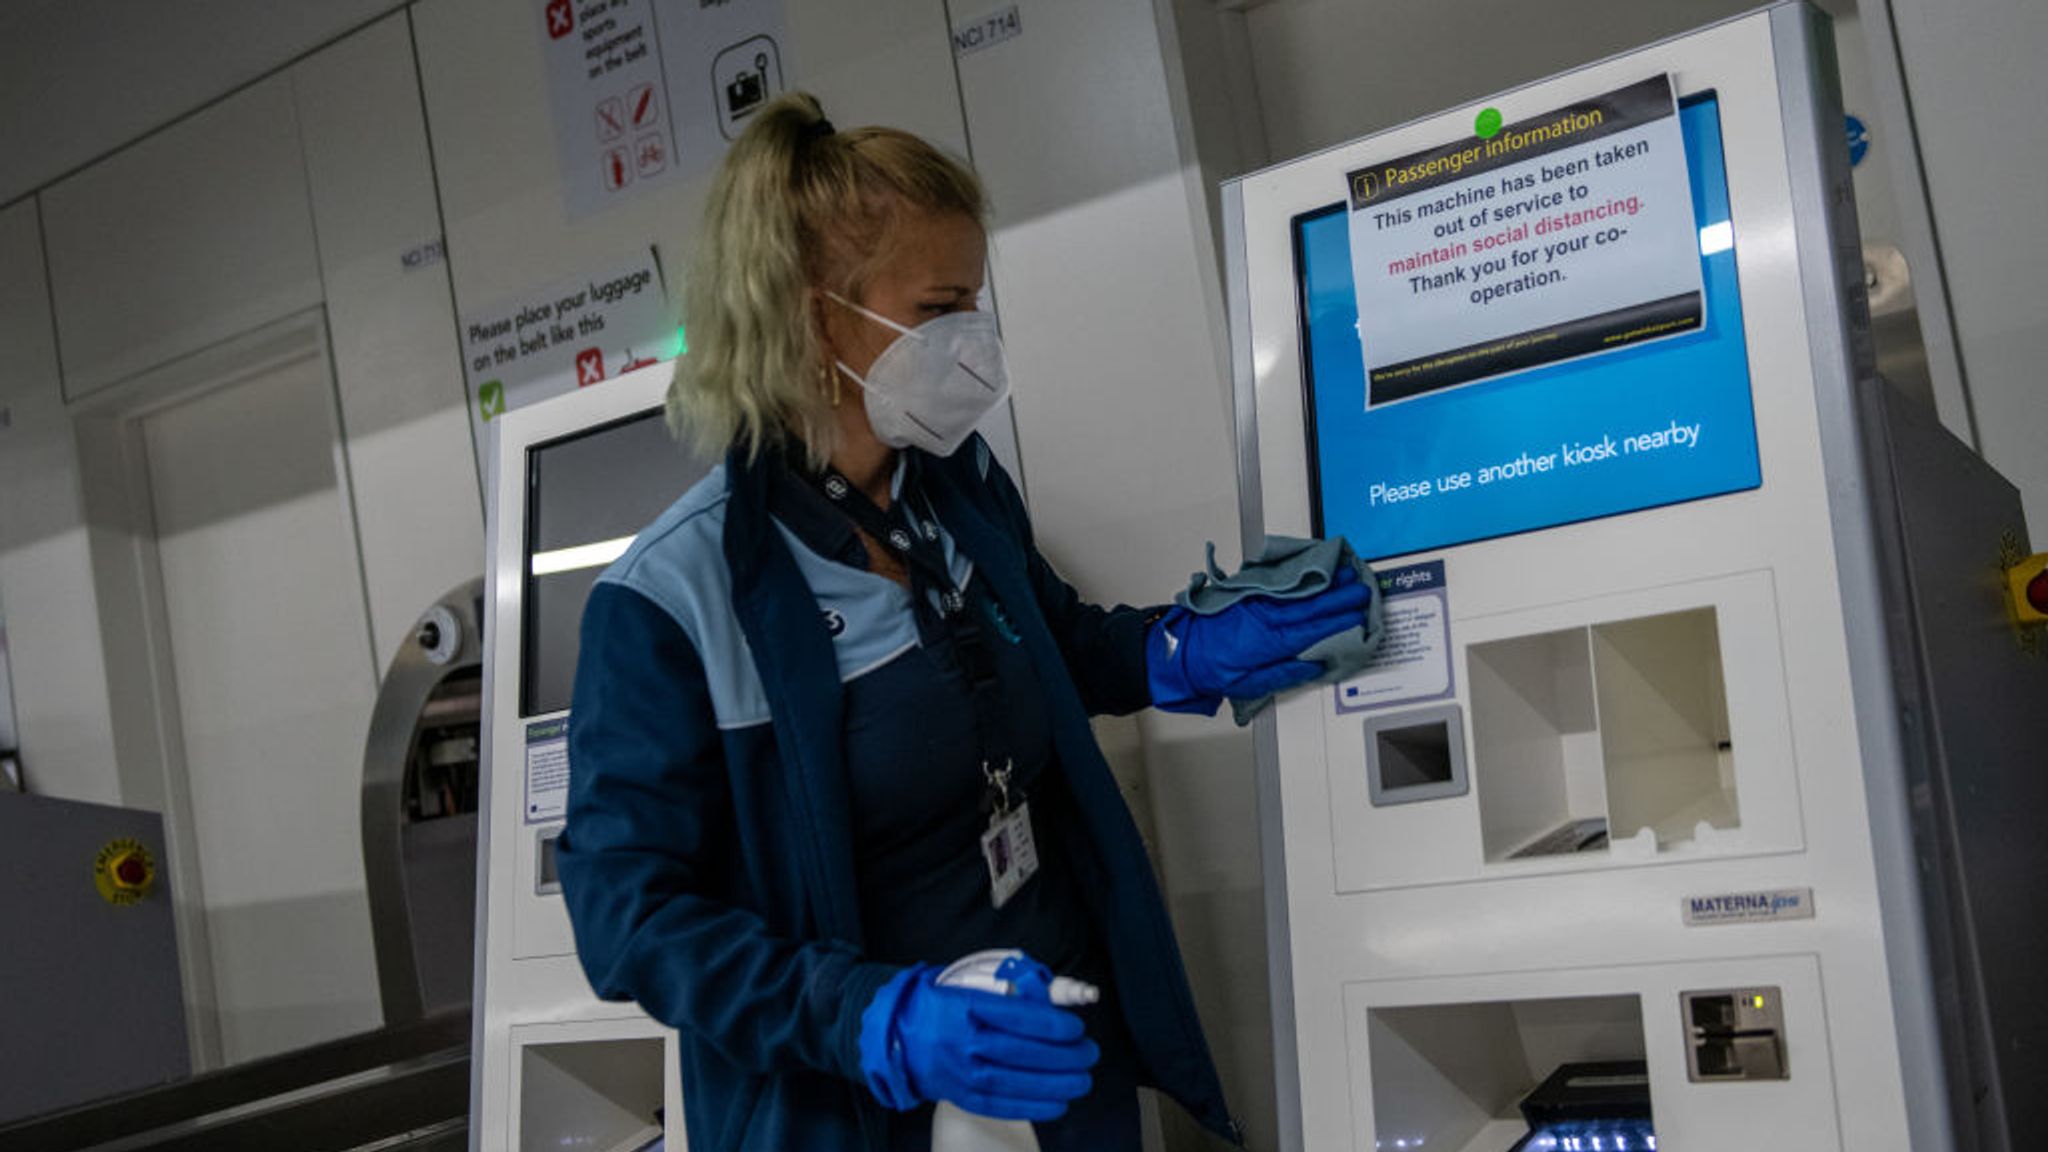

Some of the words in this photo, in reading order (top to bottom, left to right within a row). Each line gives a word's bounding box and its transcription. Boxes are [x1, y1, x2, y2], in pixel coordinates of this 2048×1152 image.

[954, 26, 983, 49] NCI
[987, 12, 1017, 39] 714
[1385, 146, 1481, 188] Passenger
[1486, 109, 1603, 158] information
[1373, 208, 1412, 231] This
[1418, 185, 1495, 219] machine
[1501, 173, 1536, 195] has
[1541, 157, 1590, 183] been
[1595, 139, 1650, 167] taken
[1434, 217, 1465, 238] out
[1470, 208, 1488, 228] of
[1493, 191, 1563, 221] service
[1569, 184, 1588, 201] to
[1388, 242, 1467, 276] maintain
[1472, 223, 1528, 252] social
[1534, 196, 1645, 236] distancing.
[1409, 266, 1466, 294] Thank
[1472, 257, 1506, 283] you
[1511, 247, 1539, 267] for
[1544, 233, 1590, 263] your
[1595, 227, 1628, 245] co-
[470, 319, 511, 343] Please
[515, 304, 551, 332] place
[555, 291, 587, 320] your
[590, 268, 651, 303] luggage
[1470, 268, 1568, 304] operation.
[473, 354, 492, 372] on
[494, 344, 517, 365] the
[519, 331, 547, 355] belt
[550, 324, 575, 345] like
[578, 312, 605, 336] this
[1369, 480, 1431, 507] Please
[1437, 470, 1472, 493] use
[1478, 451, 1557, 485] another
[1563, 434, 1618, 467] kiosk
[1623, 419, 1701, 456] nearby
[1396, 569, 1433, 588] rights
[1691, 893, 1769, 913] MATERNA
